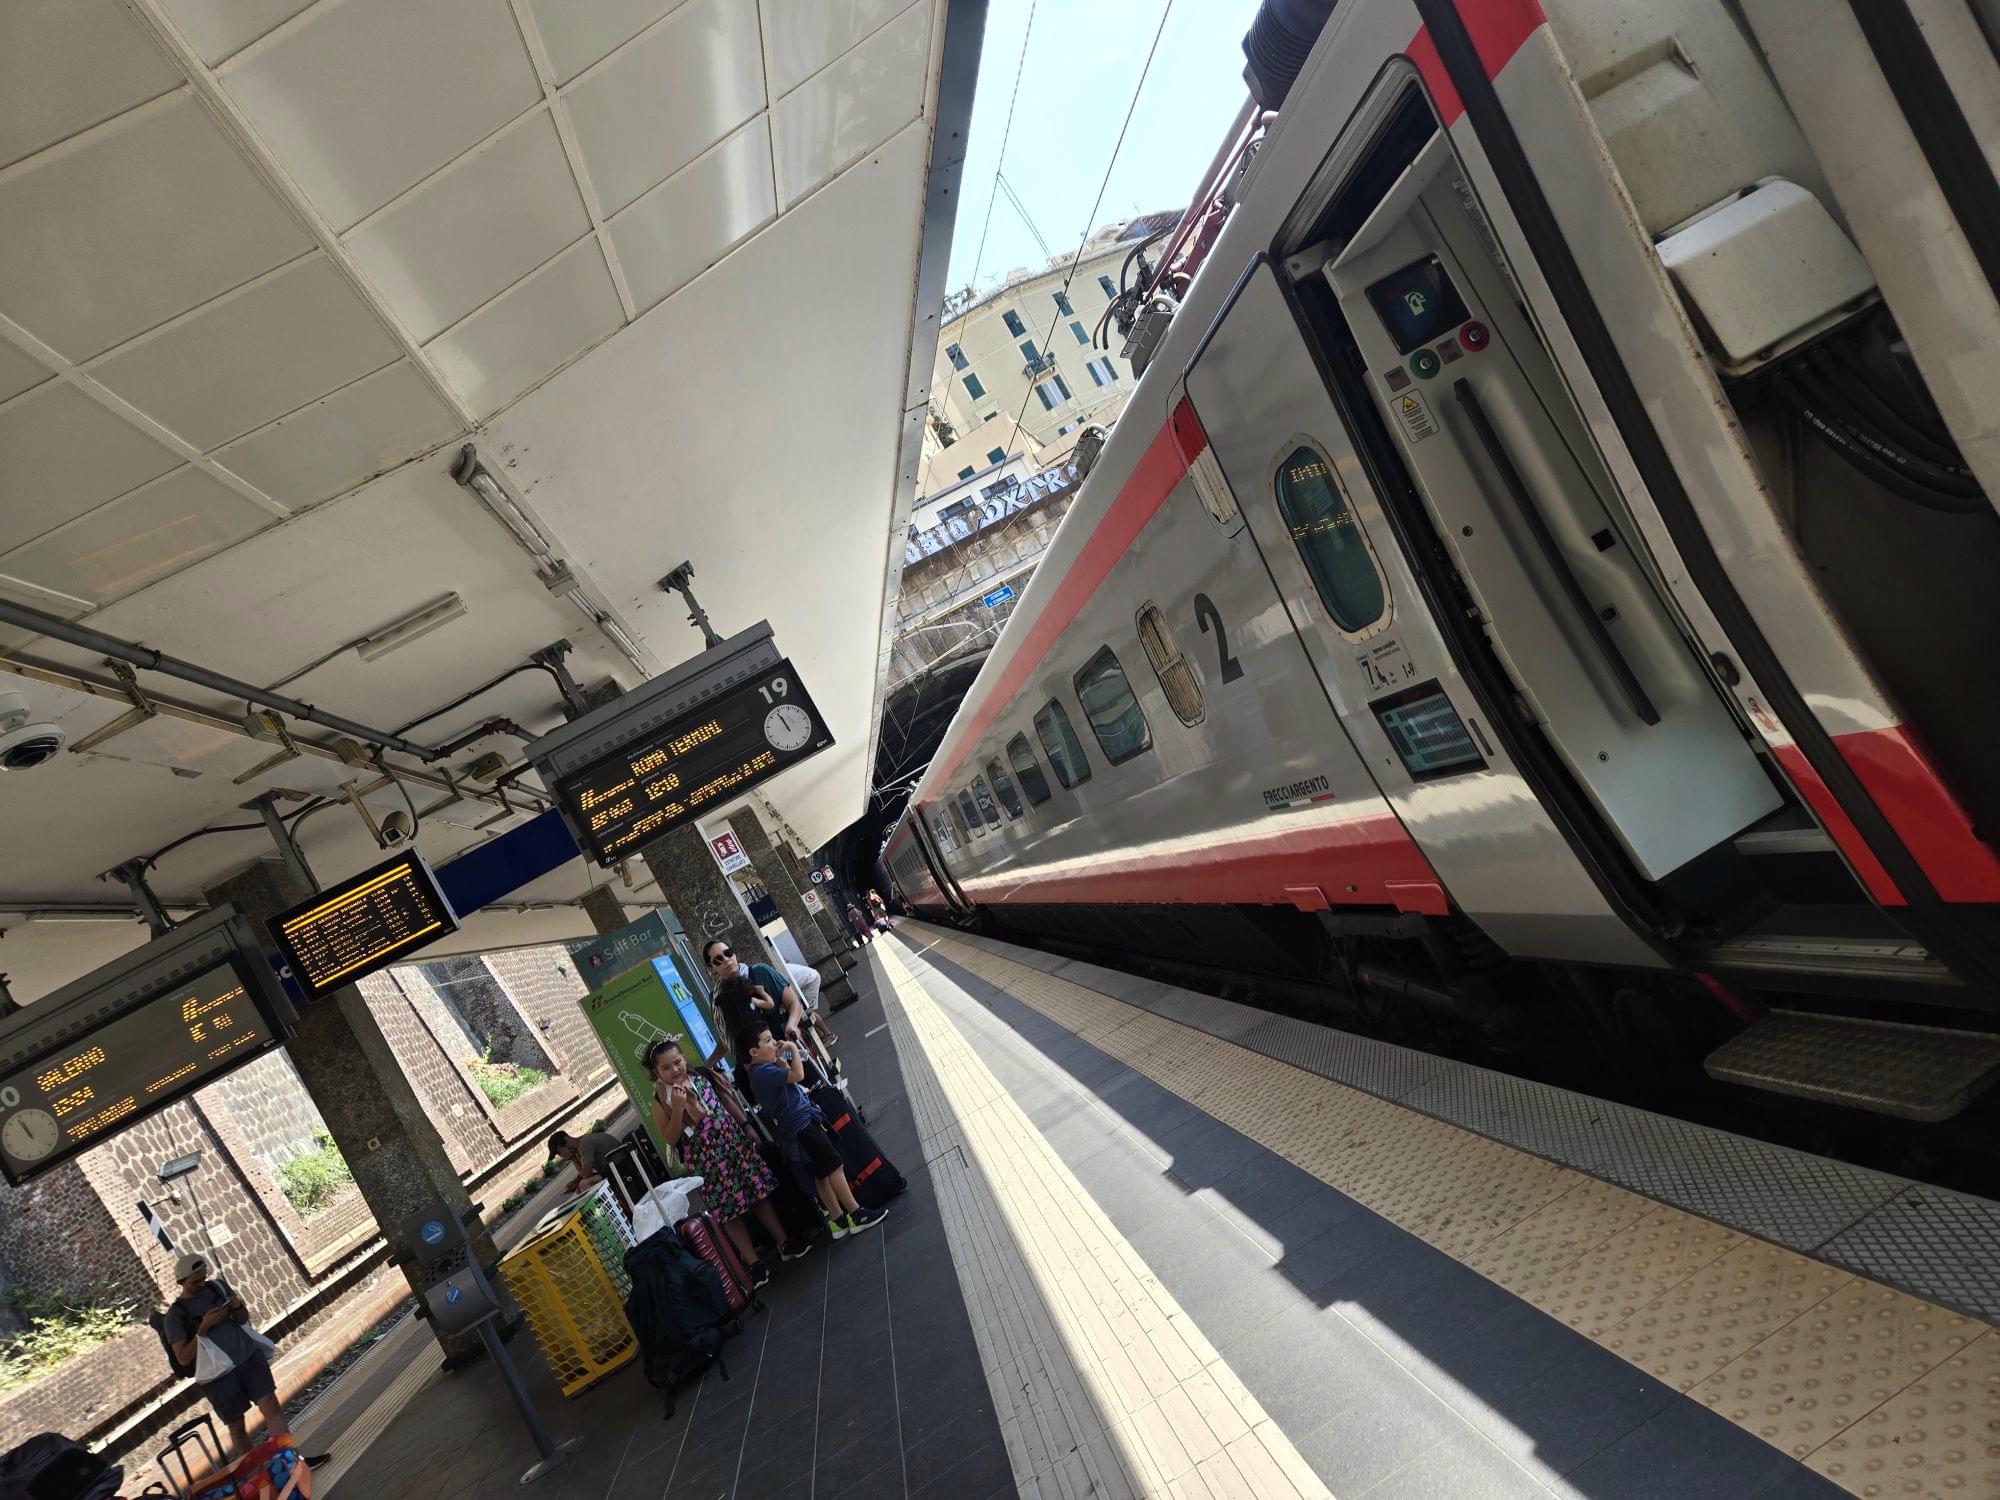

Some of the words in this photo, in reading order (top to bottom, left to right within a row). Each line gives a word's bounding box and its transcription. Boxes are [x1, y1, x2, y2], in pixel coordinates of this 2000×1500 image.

[1194, 592, 1245, 686] 2
[1361, 661, 1375, 684] 7
[758, 677, 788, 705] 19
[630, 749, 668, 777] ROMA
[668, 718, 723, 757] TERMINI
[1263, 775, 1329, 805] FRECCIARGENTO
[603, 937, 631, 961] Self
[631, 928, 653, 946] Bar
[37, 1046, 107, 1092] SALERNO
